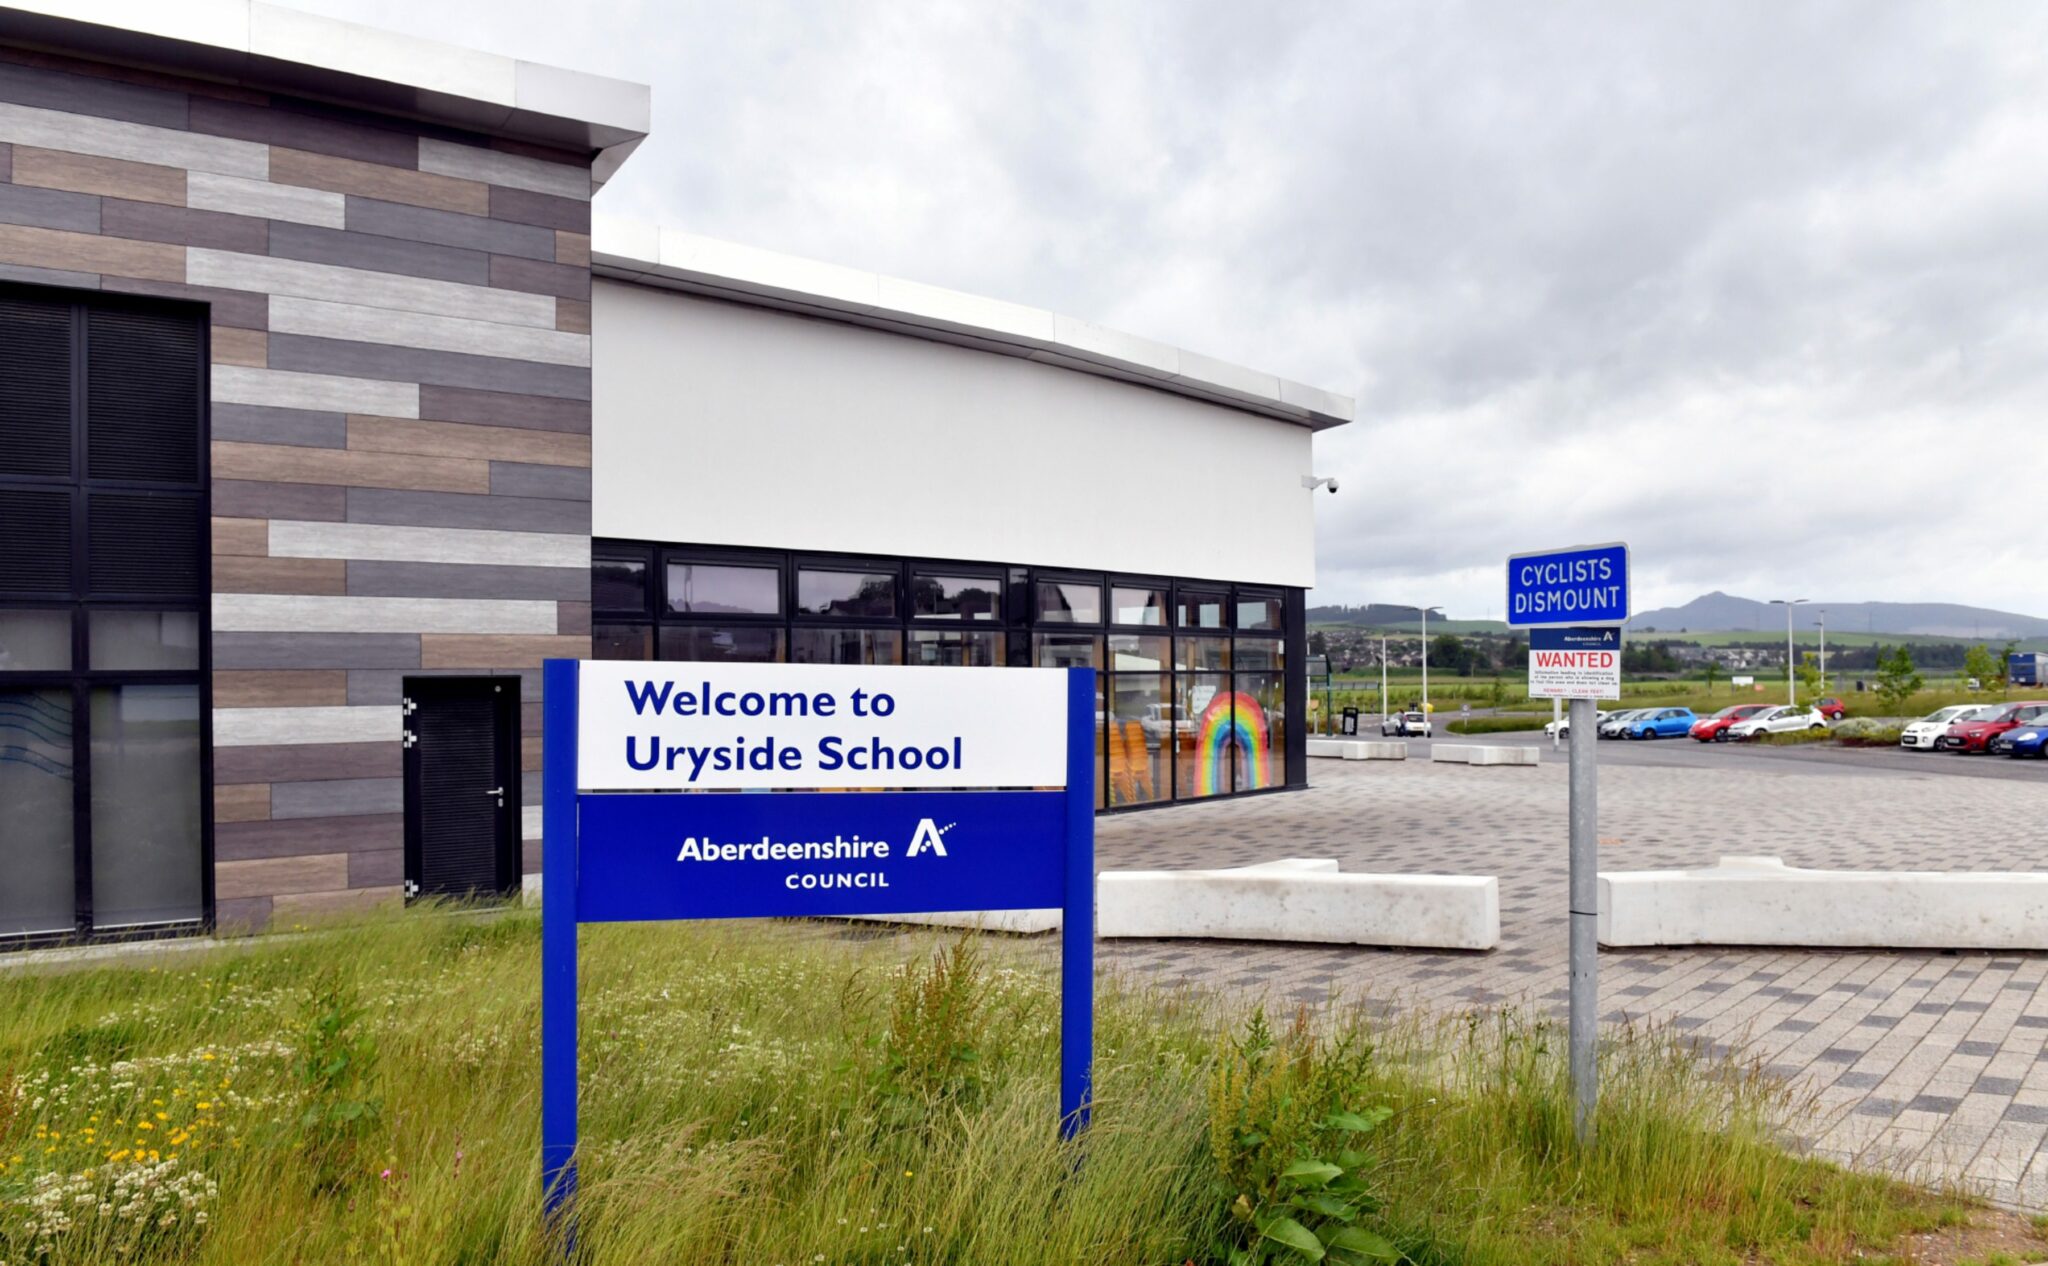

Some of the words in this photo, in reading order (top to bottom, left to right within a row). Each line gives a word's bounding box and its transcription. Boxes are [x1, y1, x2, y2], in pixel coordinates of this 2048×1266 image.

[1521, 557, 1612, 587] CYCLISTS
[1515, 586, 1620, 613] DISMOUNT
[1536, 651, 1613, 668] WANTED
[625, 681, 836, 716] Welcome
[851, 687, 895, 716] to
[626, 735, 802, 781] Uryside
[818, 735, 962, 770] School
[677, 834, 890, 861] Aberdeenshire
[785, 872, 890, 890] COUNCIL
